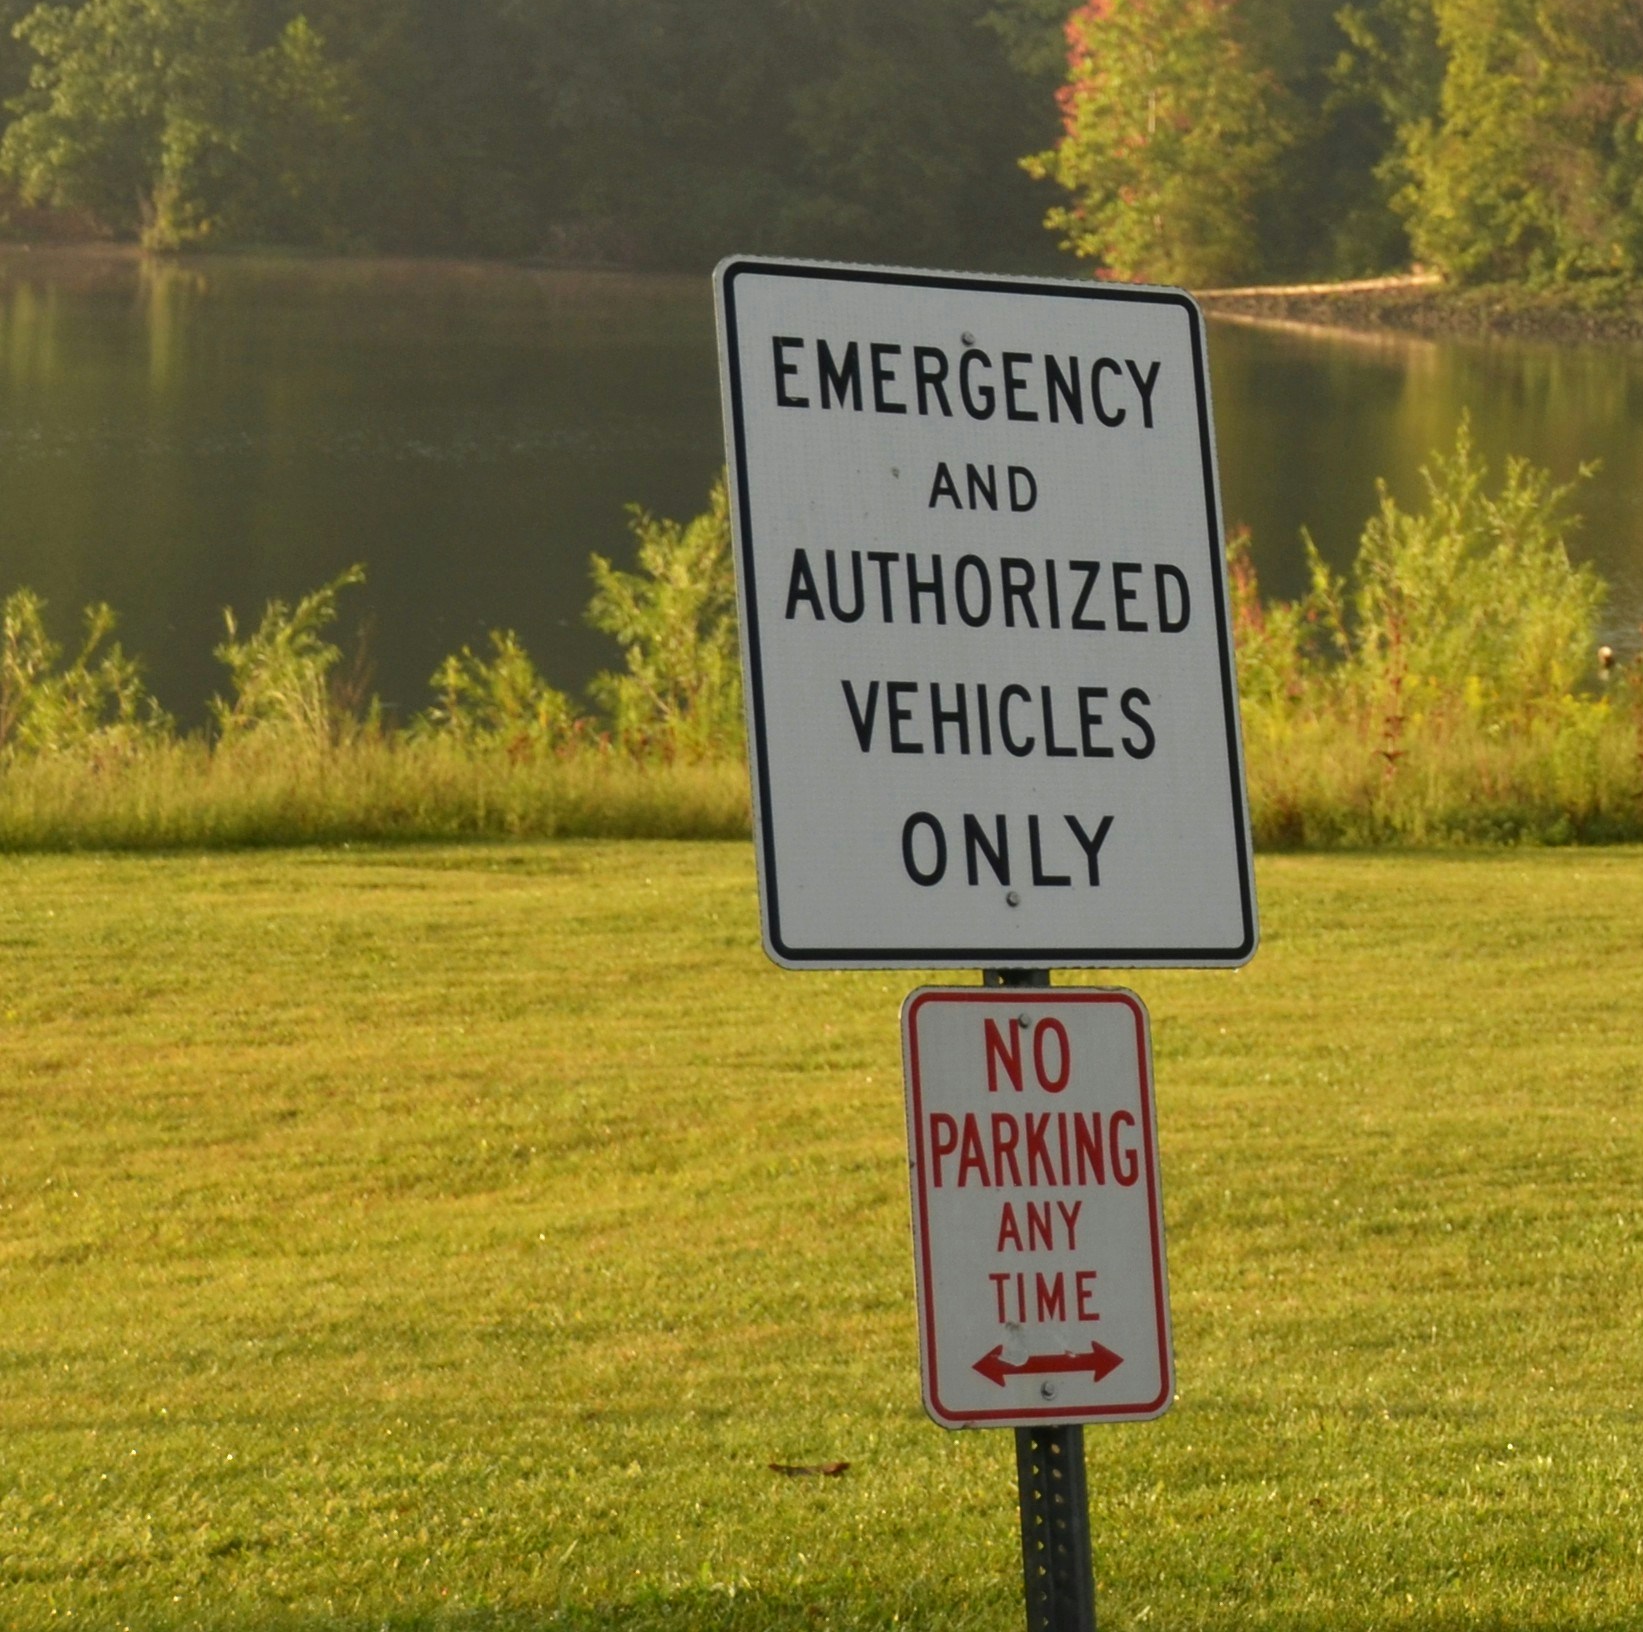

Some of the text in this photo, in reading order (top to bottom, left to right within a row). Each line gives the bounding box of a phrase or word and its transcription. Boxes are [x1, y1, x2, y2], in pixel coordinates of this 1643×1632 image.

[771, 335, 1162, 430] EMERGENCY
[927, 461, 1038, 513] AND
[784, 547, 1192, 634] AUTHORIZED
[840, 679, 1157, 761] VEHICLES
[900, 810, 1116, 888] ONLY
[983, 1016, 1072, 1095] NO
[928, 1109, 1141, 1190] PARKING
[996, 1200, 1083, 1253] ANY
[988, 1269, 1101, 1325] TIME
